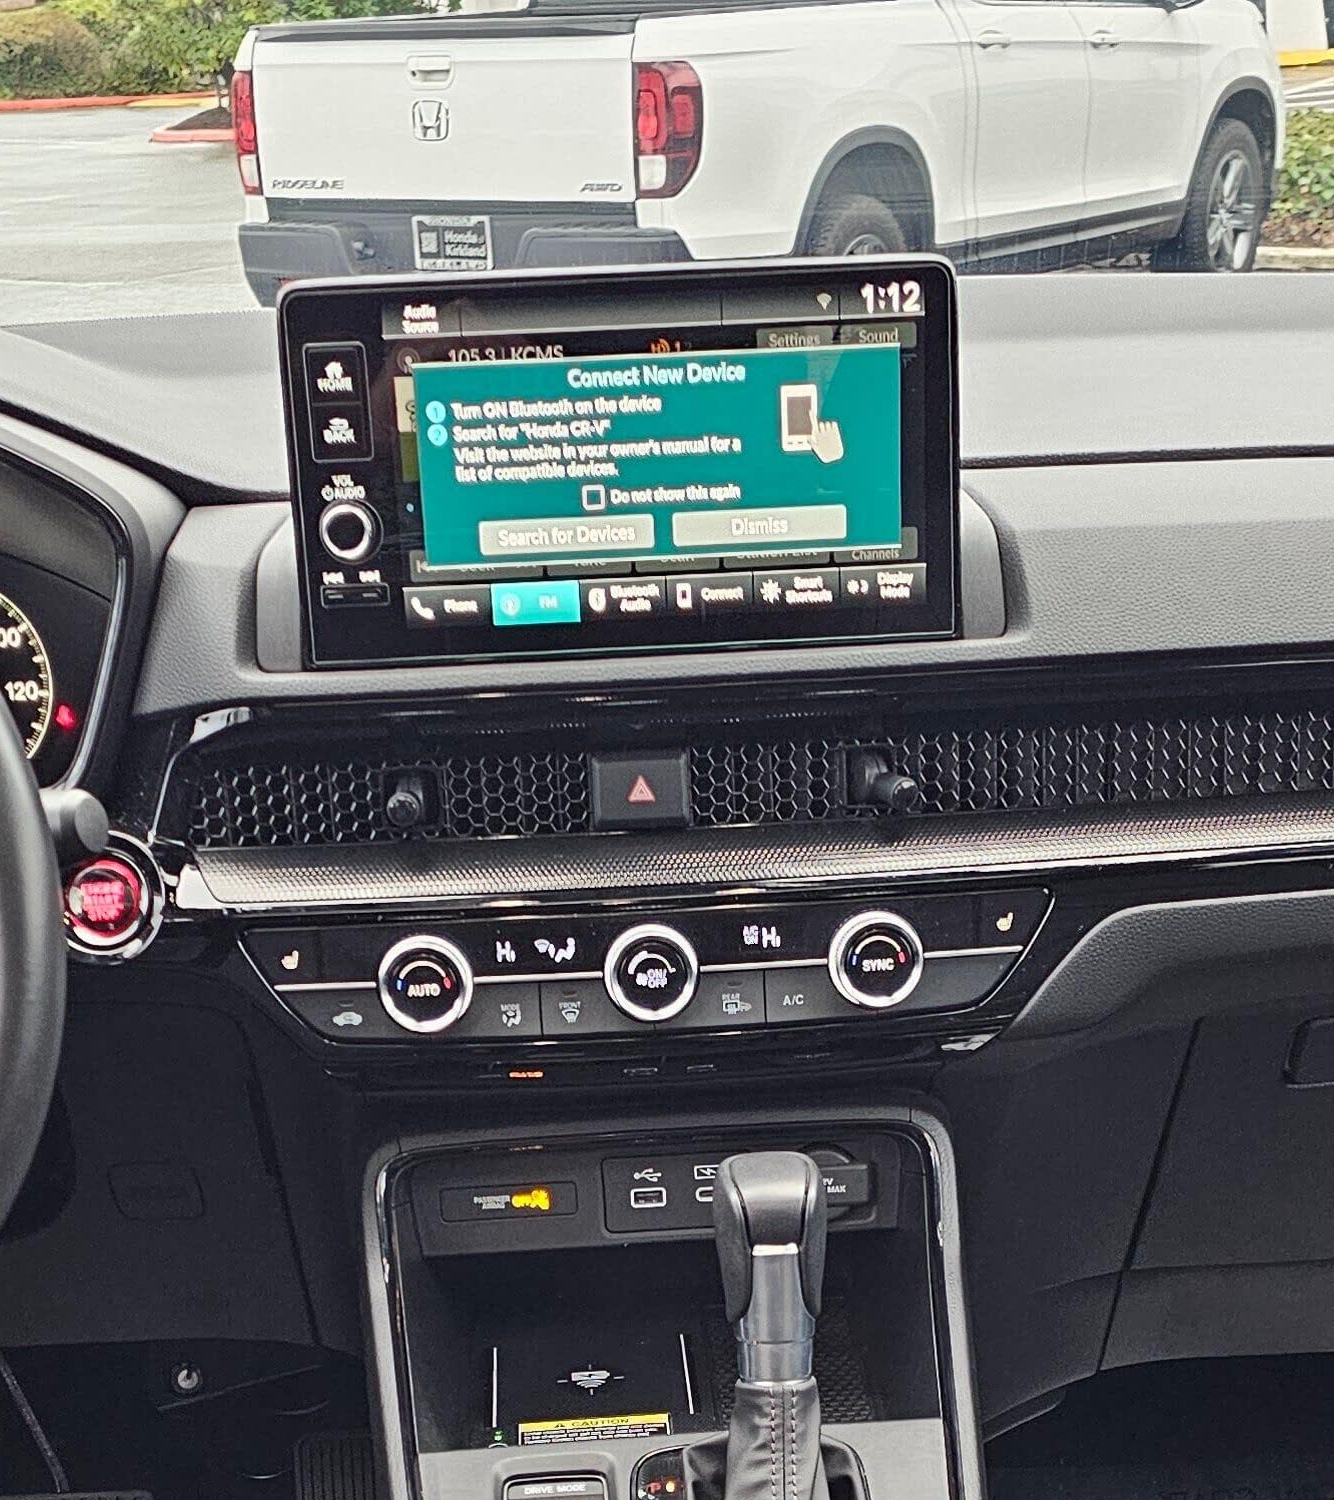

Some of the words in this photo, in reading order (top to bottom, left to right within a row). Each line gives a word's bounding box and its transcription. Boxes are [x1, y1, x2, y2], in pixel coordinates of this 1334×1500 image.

[271, 178, 345, 192] RIDGELINE
[579, 182, 623, 193] AWD
[444, 229, 478, 245] Honda
[445, 243, 487, 258] Kirkland
[860, 280, 922, 314] 1:12
[403, 303, 437, 320] Audio
[402, 318, 439, 335] Source
[768, 332, 821, 348] Settings
[858, 327, 899, 344] Sound
[510, 345, 564, 360] KCMS
[567, 366, 640, 388] Connect
[642, 364, 685, 385] New
[686, 362, 746, 383] Device
[317, 376, 353, 392] HOME
[451, 403, 482, 420] Turn
[483, 401, 509, 418] ON
[509, 398, 574, 417] Bluetooth
[575, 401, 593, 415] on
[594, 397, 617, 413] the
[619, 394, 662, 412] device
[323, 428, 357, 445] BACK
[452, 423, 498, 442] Search
[498, 423, 519, 440] for
[519, 421, 569, 440] "Honda
[454, 447, 485, 464] Visit
[486, 446, 509, 462] the
[511, 443, 561, 461] website
[562, 443, 577, 459] in
[577, 443, 608, 461] your
[610, 439, 661, 457] owner's
[661, 436, 710, 455] manual
[710, 436, 731, 453] for
[731, 438, 741, 453] a
[455, 465, 477, 483] list
[478, 464, 493, 481] of
[494, 462, 565, 483] compatible
[566, 459, 619, 477] devices.
[331, 474, 354, 487] VOL
[334, 484, 366, 500] AUDIO
[610, 489, 631, 504] Do
[631, 488, 653, 503] not
[653, 486, 686, 502] show
[686, 484, 709, 501] this
[709, 483, 742, 502] again
[730, 516, 789, 537] Dismiss
[497, 528, 550, 547] Search
[551, 527, 573, 545] for
[576, 525, 636, 544] Devices
[851, 548, 900, 561] Channels
[793, 576, 824, 589] Smart
[876, 570, 914, 586] Display
[609, 583, 661, 599] Bluetooth
[700, 586, 745, 602] Connect
[785, 589, 834, 605] Shortcuts
[879, 585, 911, 600] Mode
[443, 598, 479, 614] Phone
[538, 595, 558, 610] FM
[619, 598, 653, 613] Audio
[4, 679, 40, 702] 120
[862, 958, 895, 972] SYNC
[407, 982, 441, 998] AUTO
[558, 1001, 581, 1010] FRONT
[783, 994, 804, 1006] A/C
[827, 1185, 847, 1193] MAX
[571, 1418, 629, 1428] CAUTION
[523, 1485, 554, 1494] DRIVE
[556, 1483, 587, 1493] MODE
